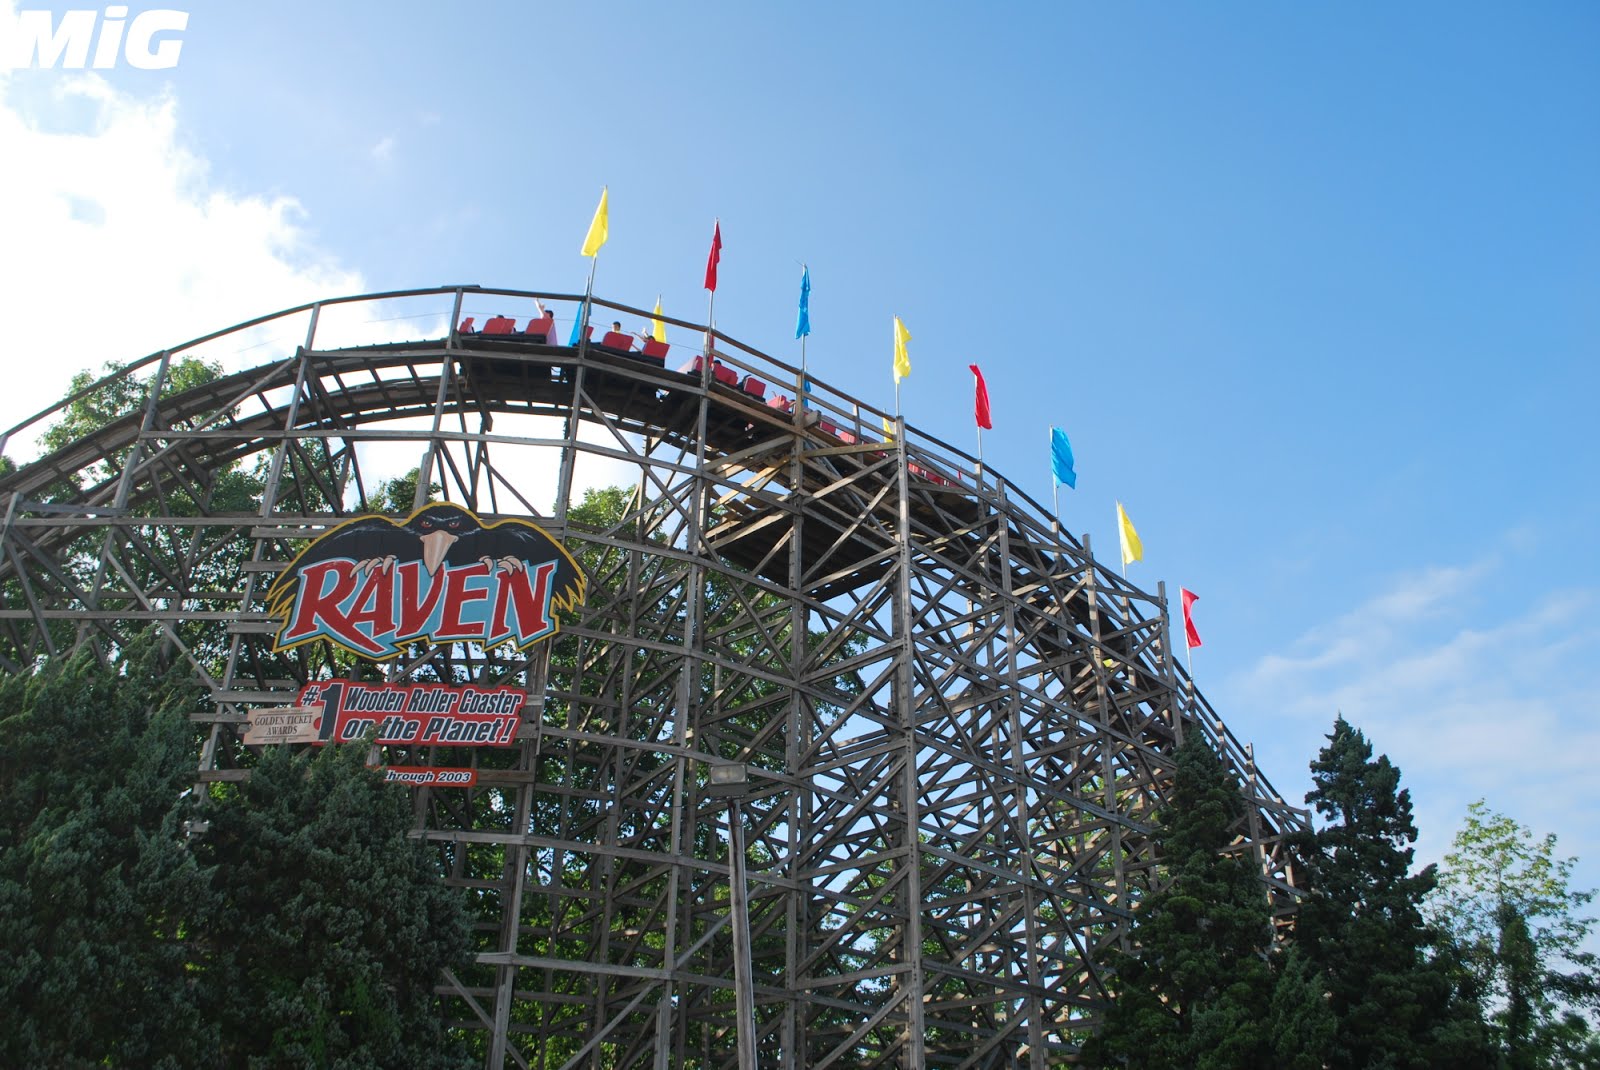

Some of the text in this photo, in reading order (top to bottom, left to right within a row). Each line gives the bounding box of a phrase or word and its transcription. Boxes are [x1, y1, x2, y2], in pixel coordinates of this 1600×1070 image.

[285, 560, 555, 652] RAVEN
[255, 714, 313, 726] GOLDEN TICKET
[301, 683, 522, 741] #1 Wooden Roller Coaster
[266, 726, 298, 735] AWARDS
[341, 716, 518, 743] on the Planet!
[385, 770, 472, 784] hrough 2003
